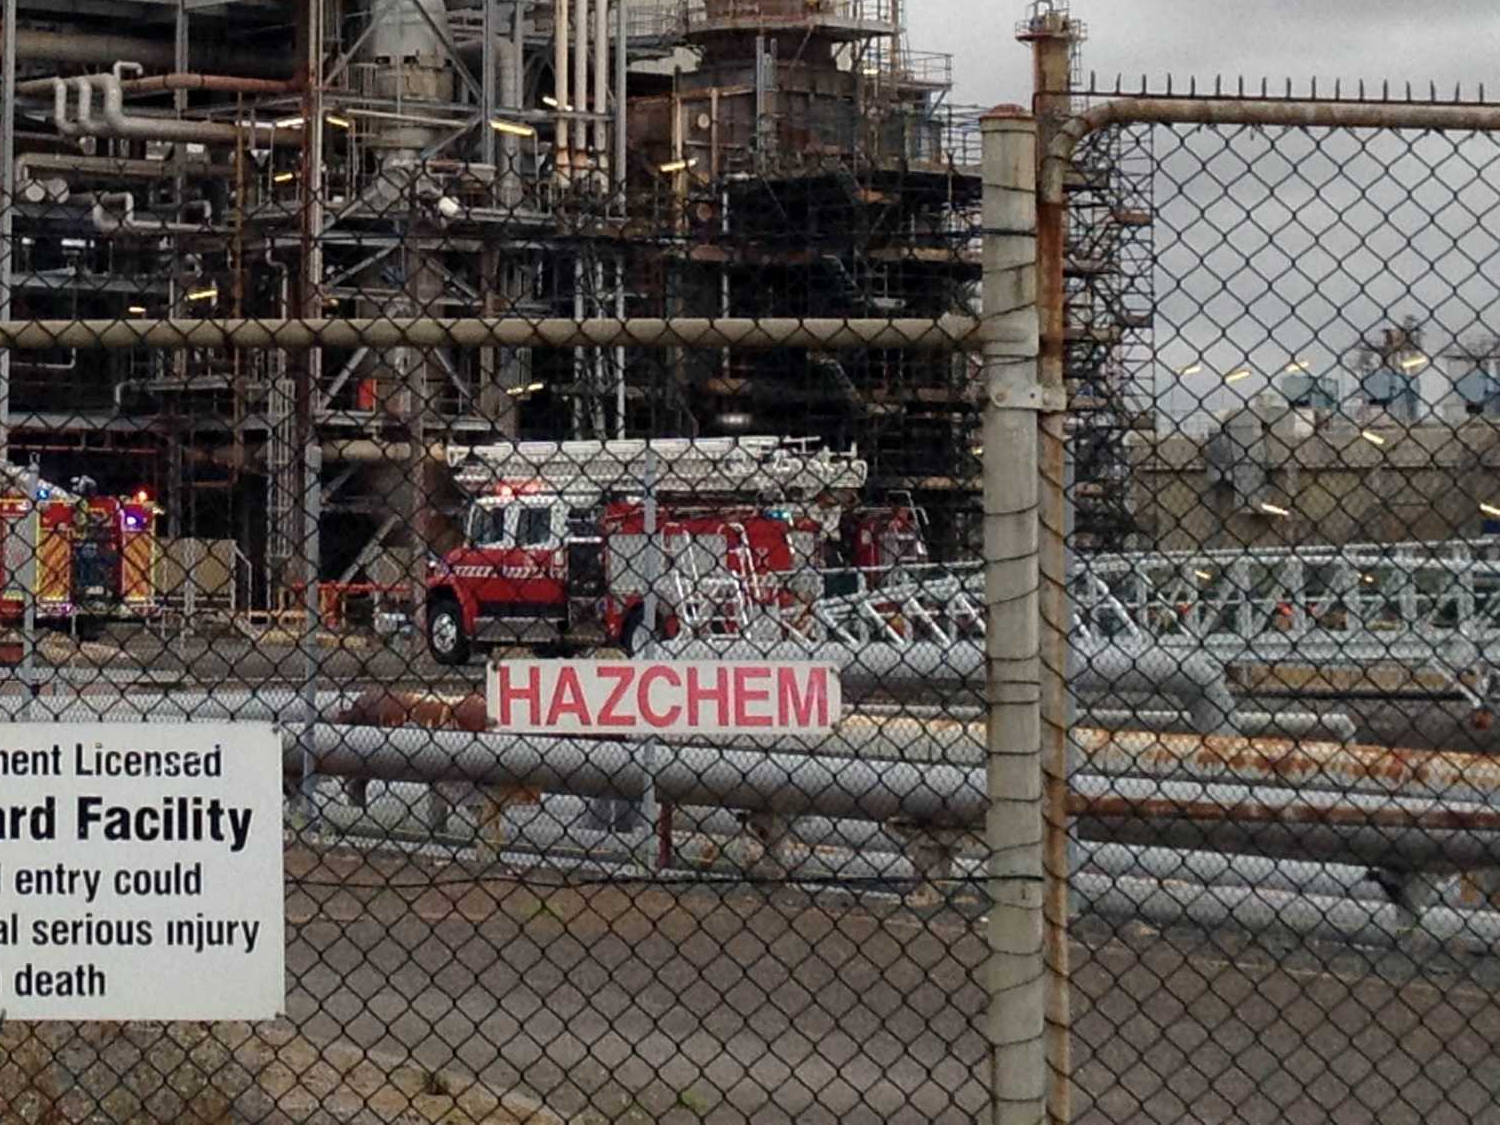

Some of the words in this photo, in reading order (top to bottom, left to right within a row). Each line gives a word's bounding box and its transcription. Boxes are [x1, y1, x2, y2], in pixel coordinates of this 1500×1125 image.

[500, 666, 829, 728] HAZCHEM
[76, 743, 222, 777] Licensed
[77, 797, 253, 852] Facility
[15, 864, 100, 903] entry
[114, 863, 202, 896] could
[32, 913, 152, 946] serious
[167, 913, 260, 953] injury
[15, 963, 106, 997] death
